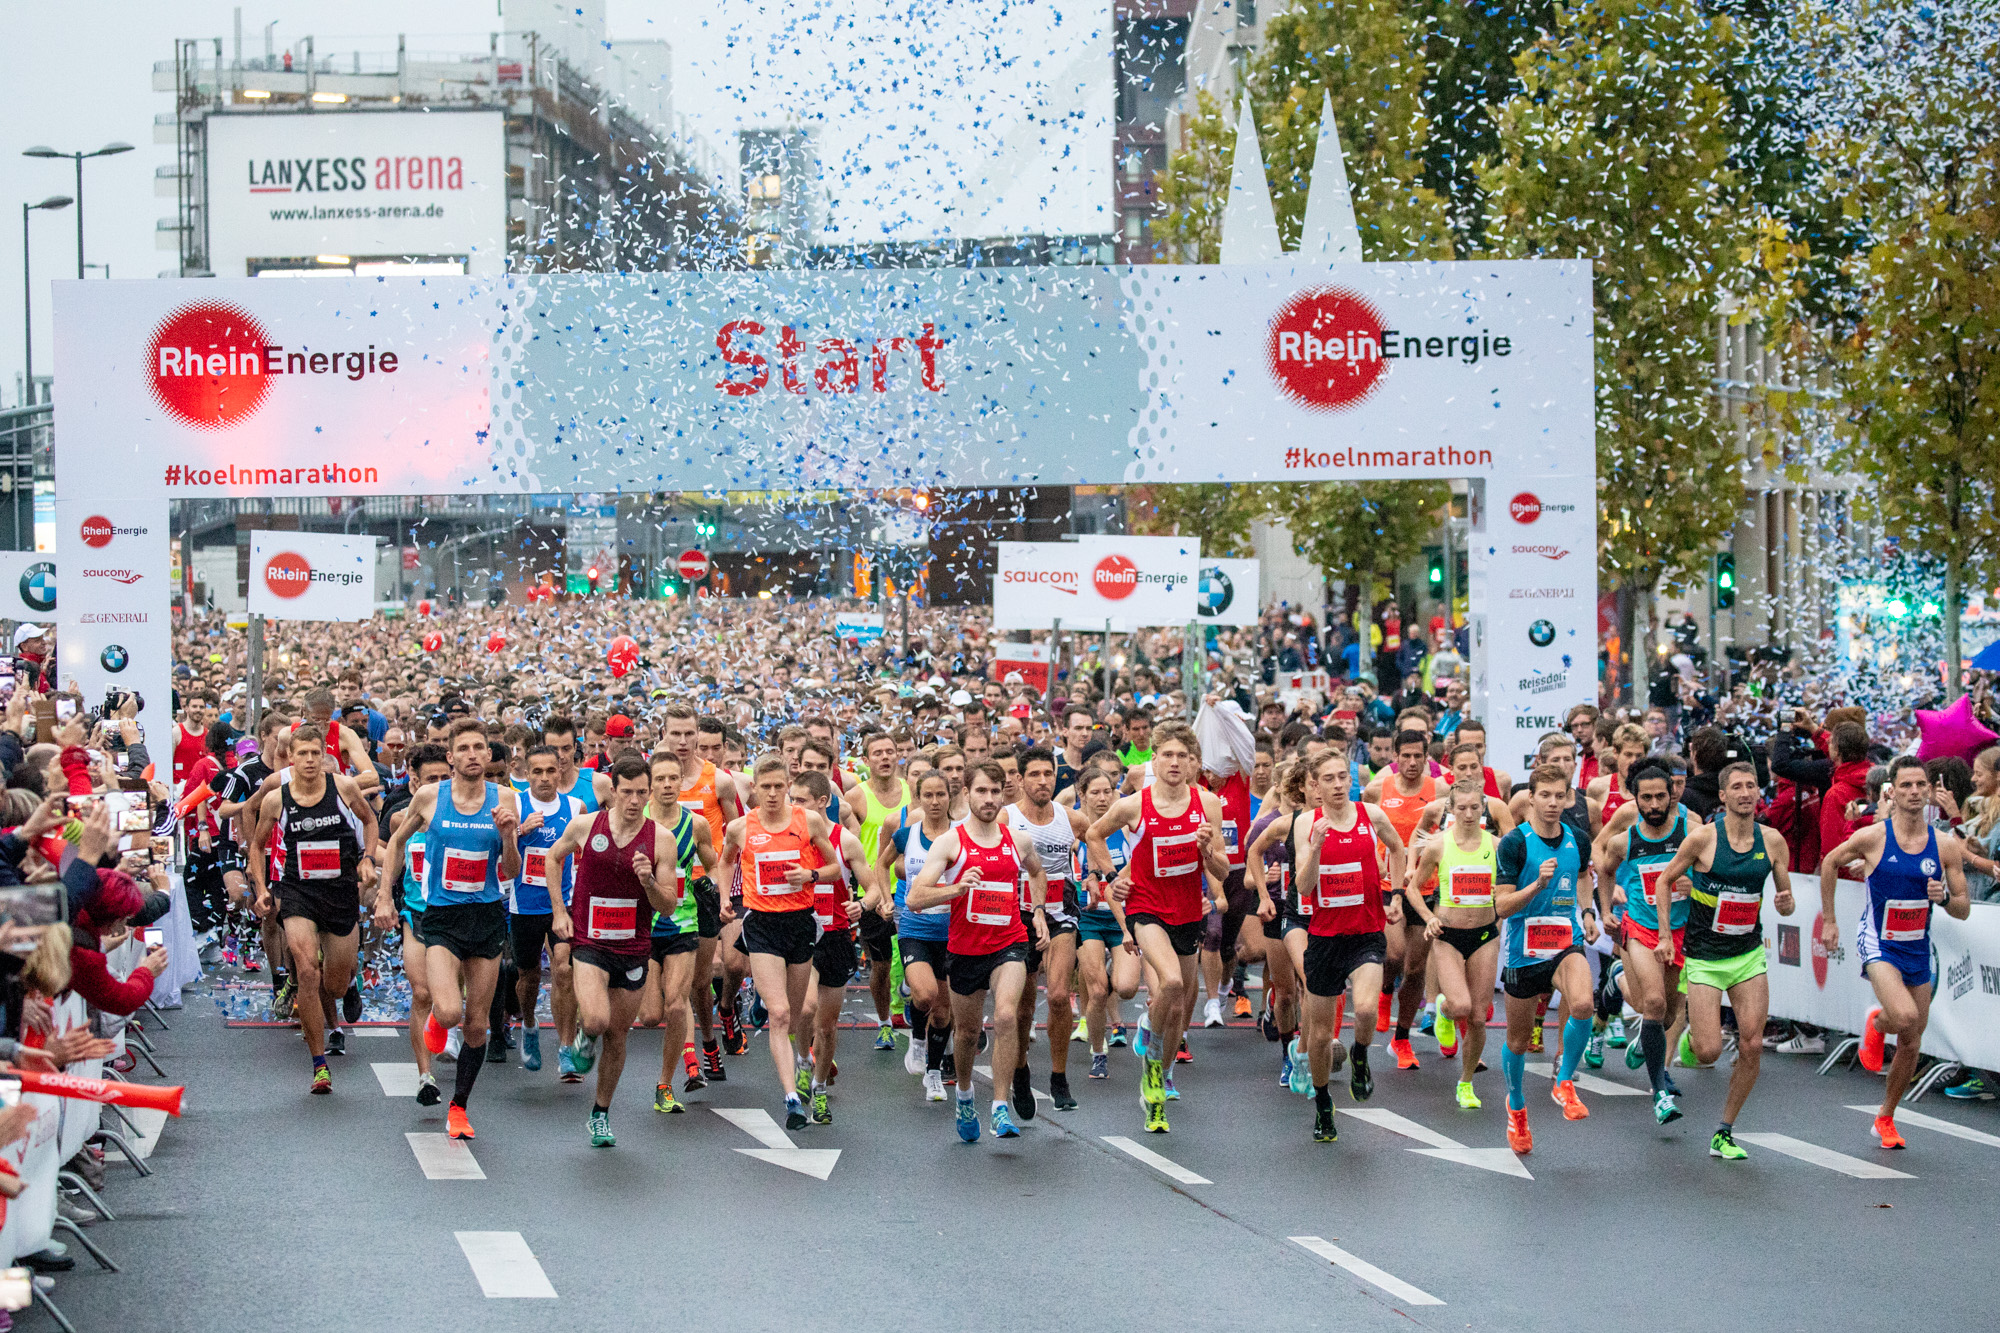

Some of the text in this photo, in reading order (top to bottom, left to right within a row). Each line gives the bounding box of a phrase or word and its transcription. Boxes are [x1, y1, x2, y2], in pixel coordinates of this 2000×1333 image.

[249, 156, 464, 193] LANXESS arena
[270, 203, 444, 221] www.lanxess-arena.de
[1278, 328, 1512, 365] RheinEnergie
[159, 344, 399, 381] RheinEnergie
[715, 320, 946, 396] Start
[1284, 445, 1492, 469] #koelnmarathon
[165, 463, 378, 486] #koelnmarathon
[1511, 502, 1575, 513] RheinEnergie
[83, 526, 148, 537] RheinEnergie
[1511, 545, 1559, 555] saucony
[83, 569, 132, 579] saucony
[267, 566, 363, 585] RheinEnergie
[1096, 569, 1188, 586] RheinEnergie
[1524, 588, 1575, 598] GENERALI
[96, 613, 148, 623] GENERALI
[103, 645, 127, 655] BMW
[315, 815, 341, 827] DSHS
[451, 821, 468, 829] TELIS
[1046, 844, 1068, 853] DSHS
[458, 860, 475, 870] Erik
[761, 863, 794, 872] Torste
[1326, 874, 1355, 885] David
[1454, 875, 1489, 884] Kristina
[979, 892, 1006, 903] Patric
[596, 909, 631, 918] Florian
[1532, 927, 1566, 936] Marcel
[1979, 964, 2000, 996] REW
[40, 1073, 107, 1093] saucony
